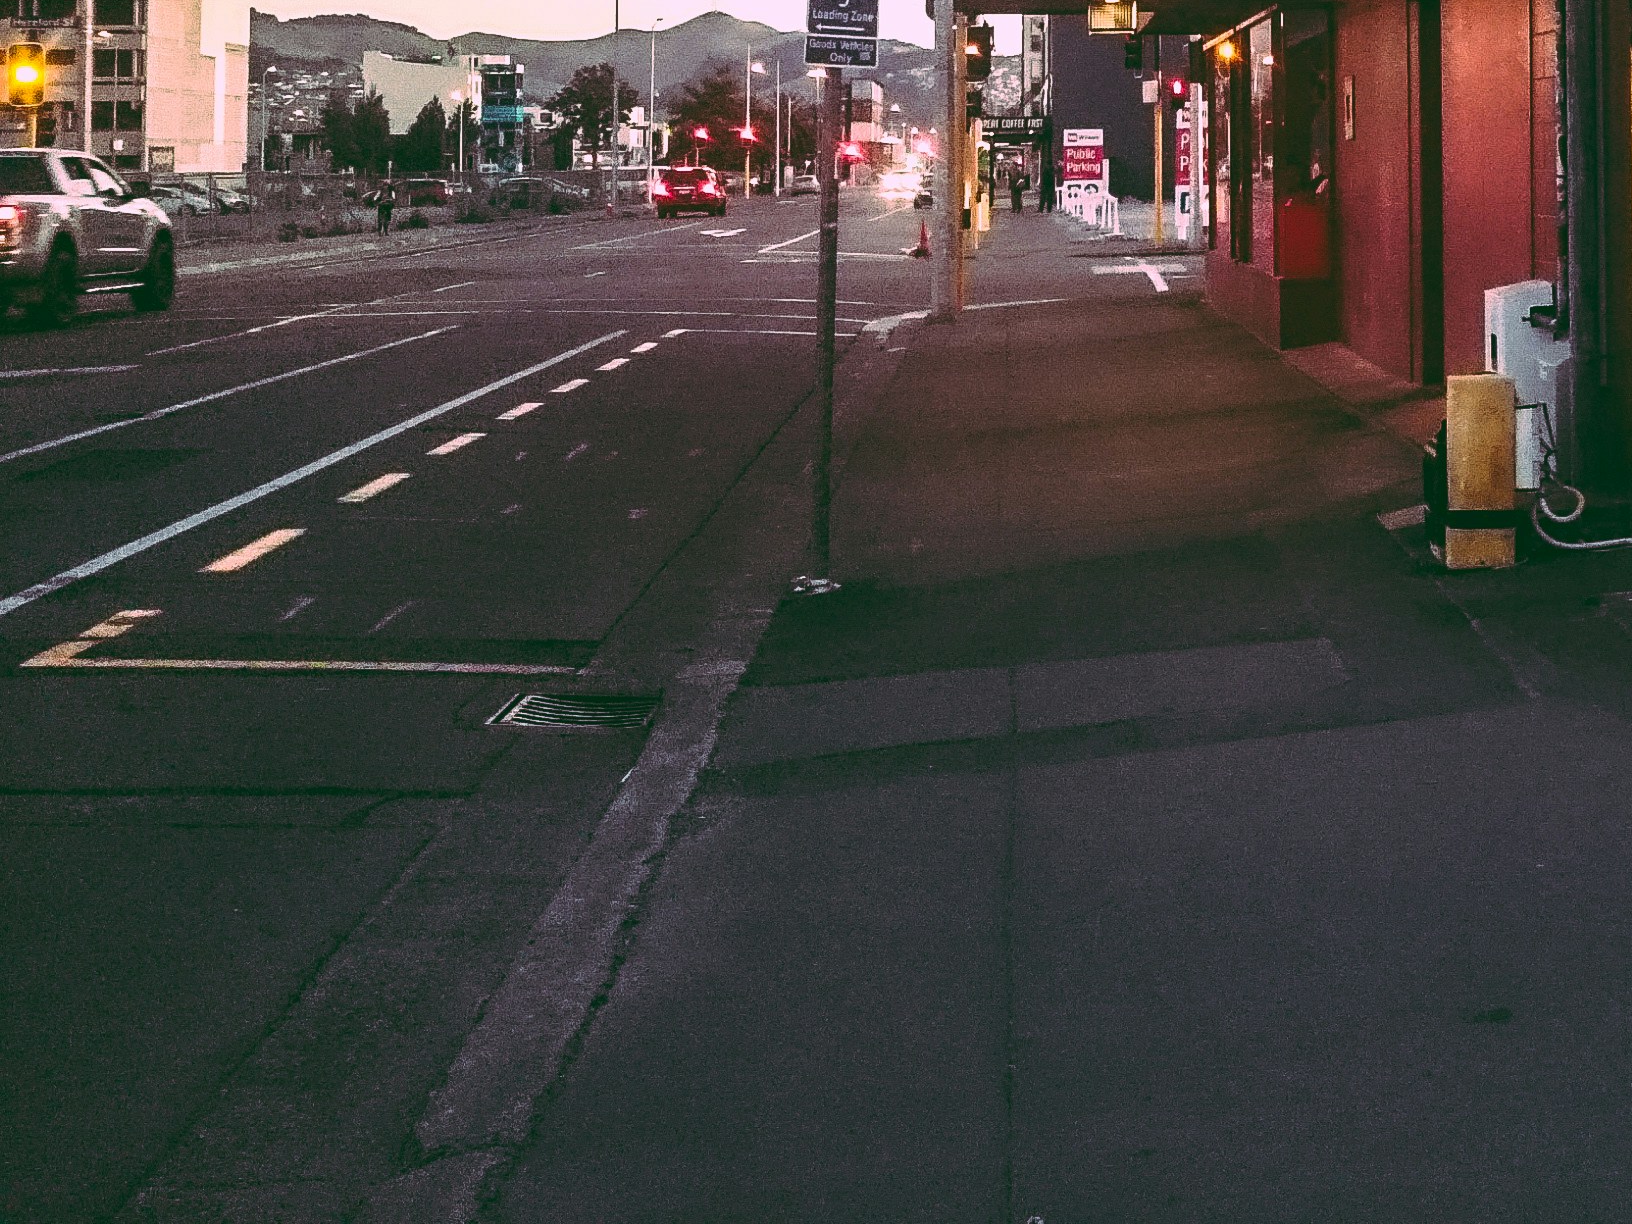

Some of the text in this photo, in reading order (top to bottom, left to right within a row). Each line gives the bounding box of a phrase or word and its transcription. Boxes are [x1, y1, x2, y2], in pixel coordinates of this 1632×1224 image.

[812, 8, 875, 23] Loading Zone
[809, 38, 874, 52] Goods Vehicles
[829, 52, 853, 64] Only
[1001, 118, 1025, 129] COFFEE
[1066, 147, 1096, 160] Public
[1066, 161, 1101, 175] Parking
